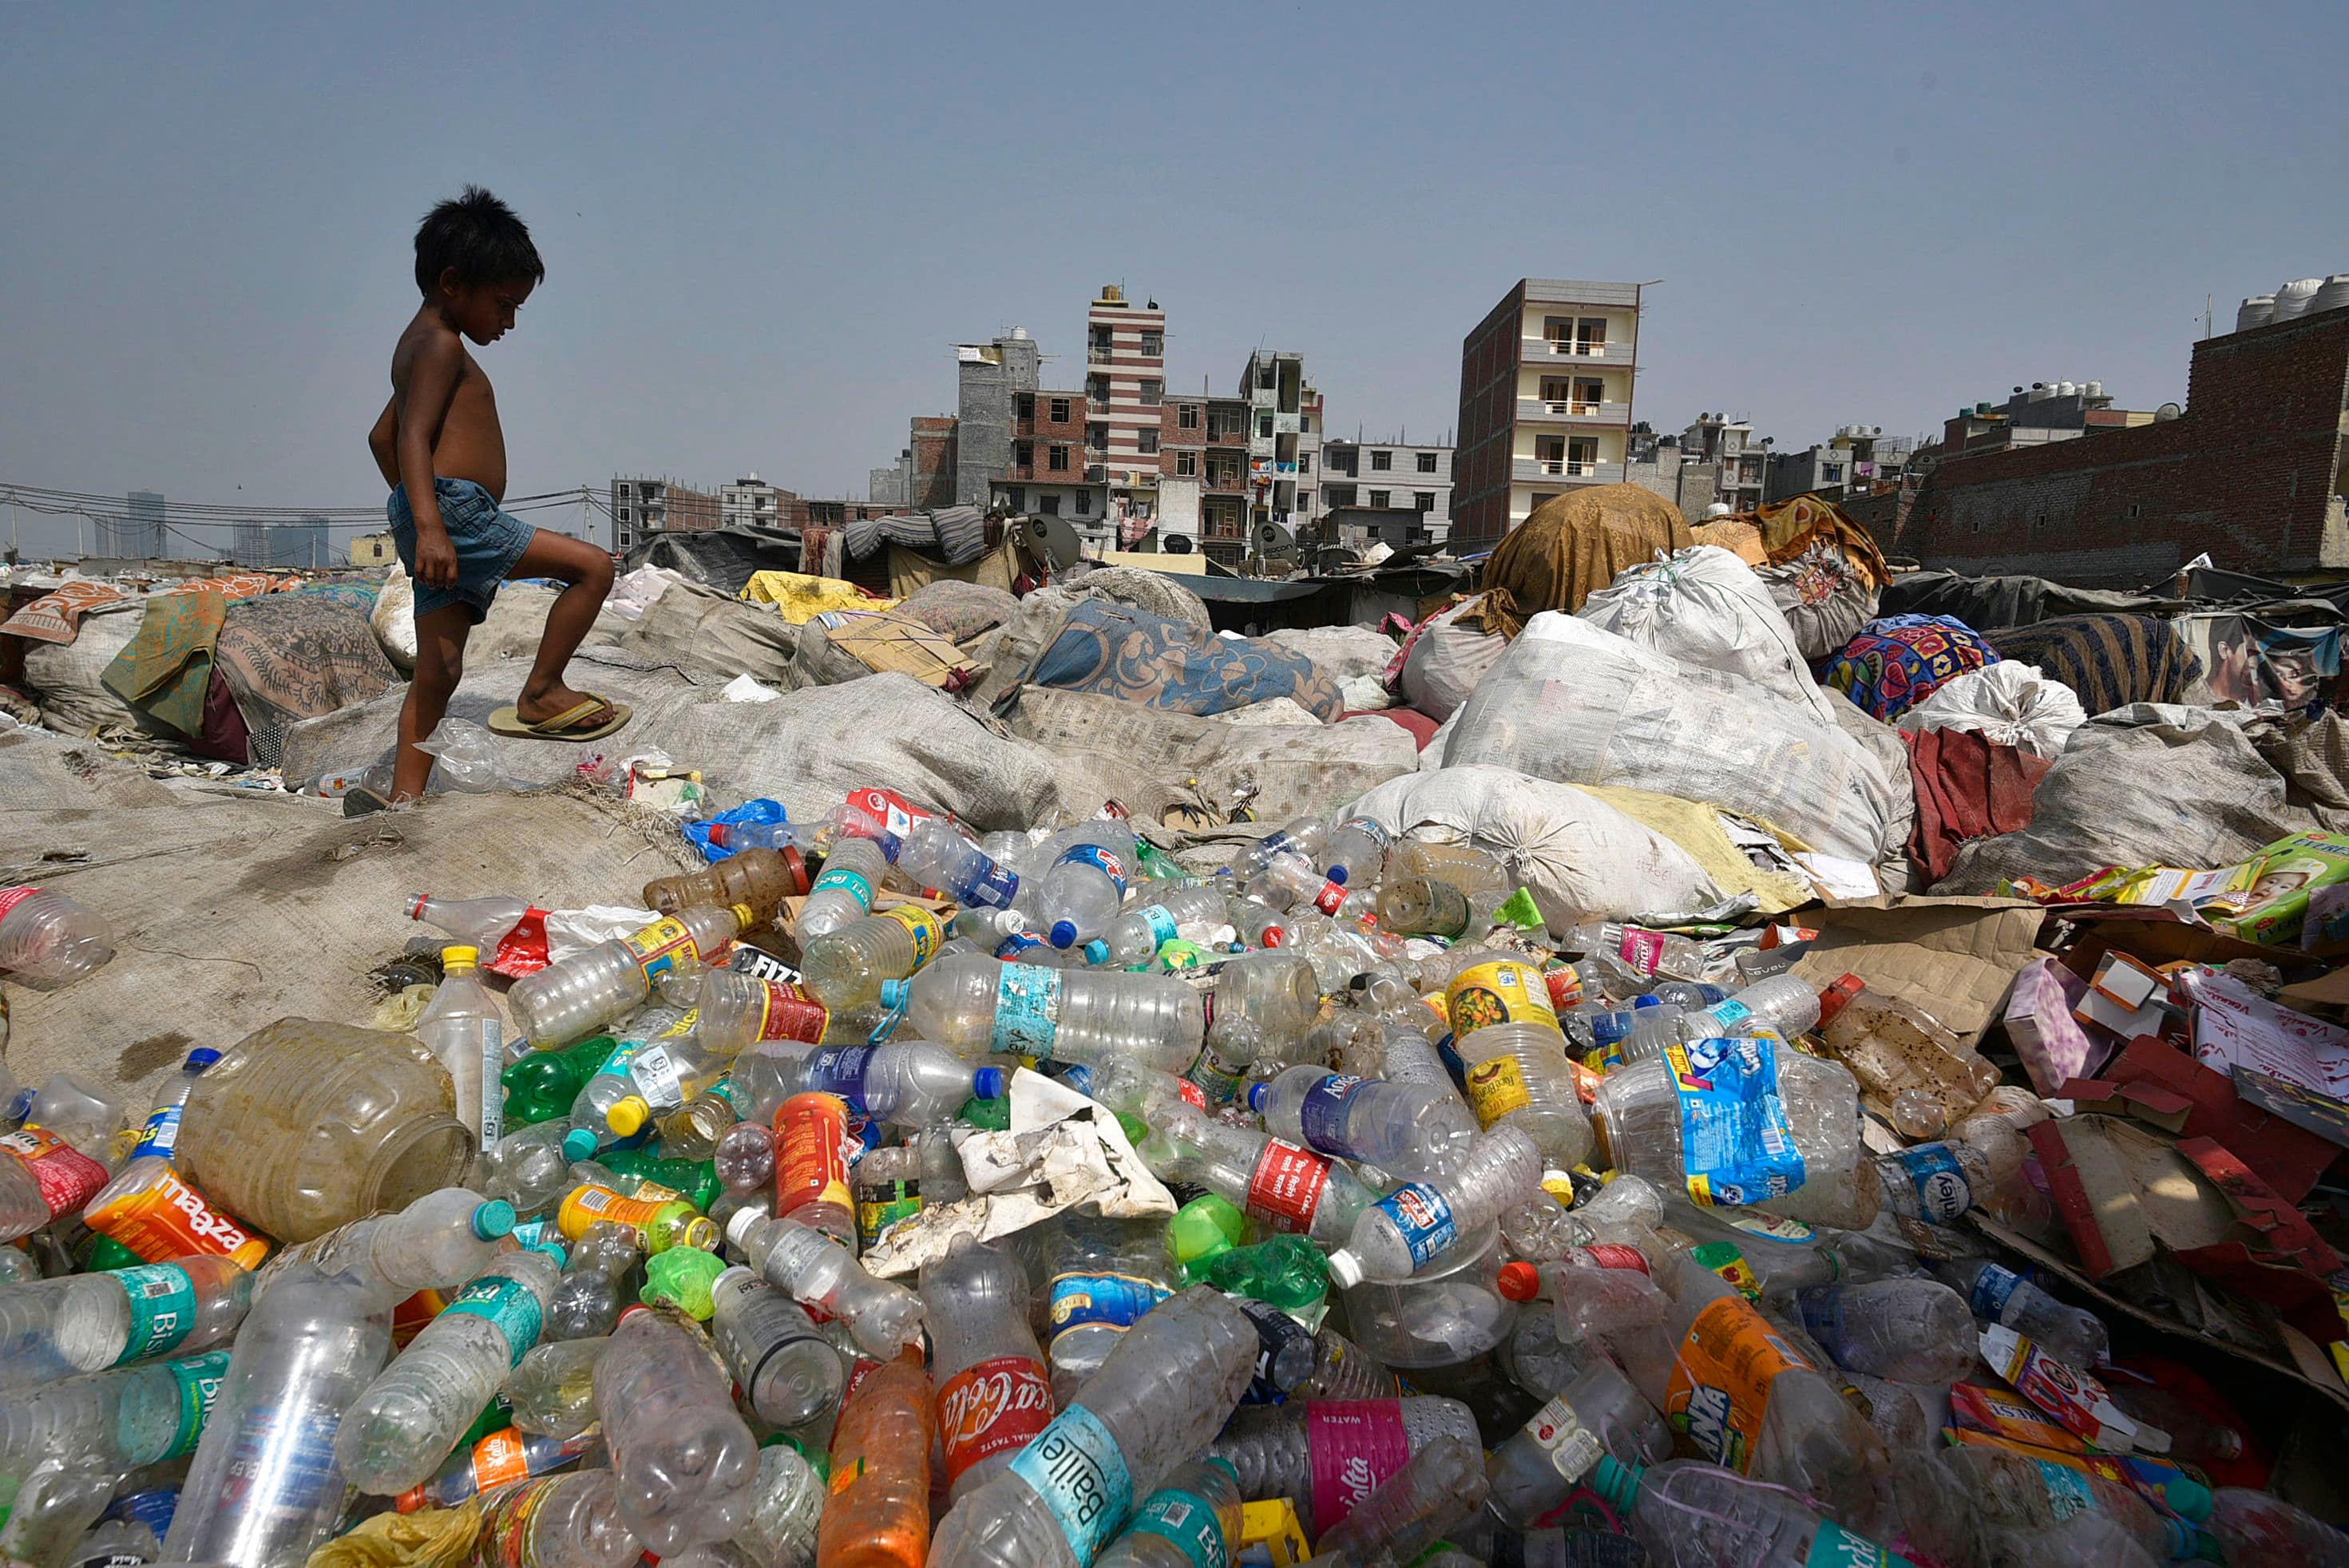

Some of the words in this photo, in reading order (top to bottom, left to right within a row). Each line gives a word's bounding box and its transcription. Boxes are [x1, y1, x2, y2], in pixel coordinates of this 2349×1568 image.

[154, 1173, 246, 1251] maaza
[944, 1370, 1056, 1451] oca-Cola
[980, 1436, 1011, 1453] TASTE
[1322, 1414, 1361, 1425] WATER
[1036, 1426, 1105, 1526] Bailley
